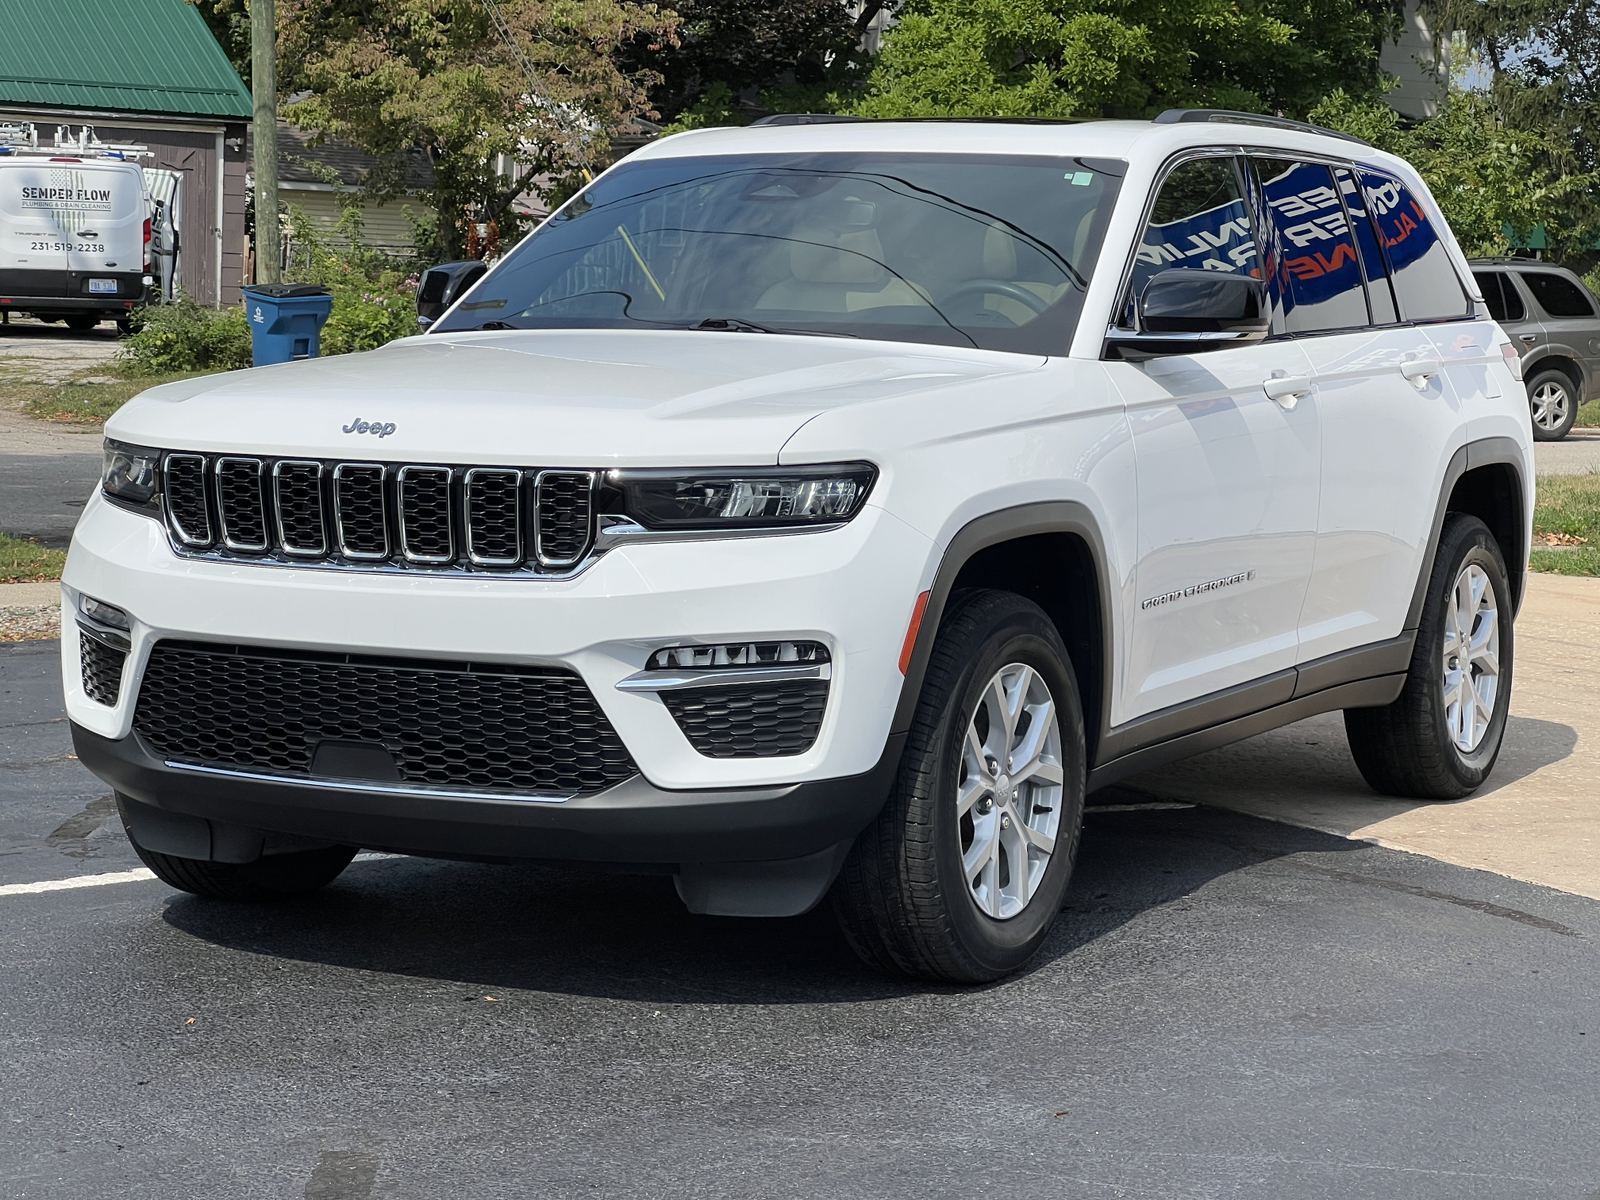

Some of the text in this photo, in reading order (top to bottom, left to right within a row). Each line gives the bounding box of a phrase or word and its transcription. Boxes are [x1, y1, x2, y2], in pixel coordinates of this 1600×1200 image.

[22, 187, 111, 201] SEMPER FLOW
[342, 417, 397, 438] Jeep
[1142, 572, 1247, 610] GRAND CHEROKEE
